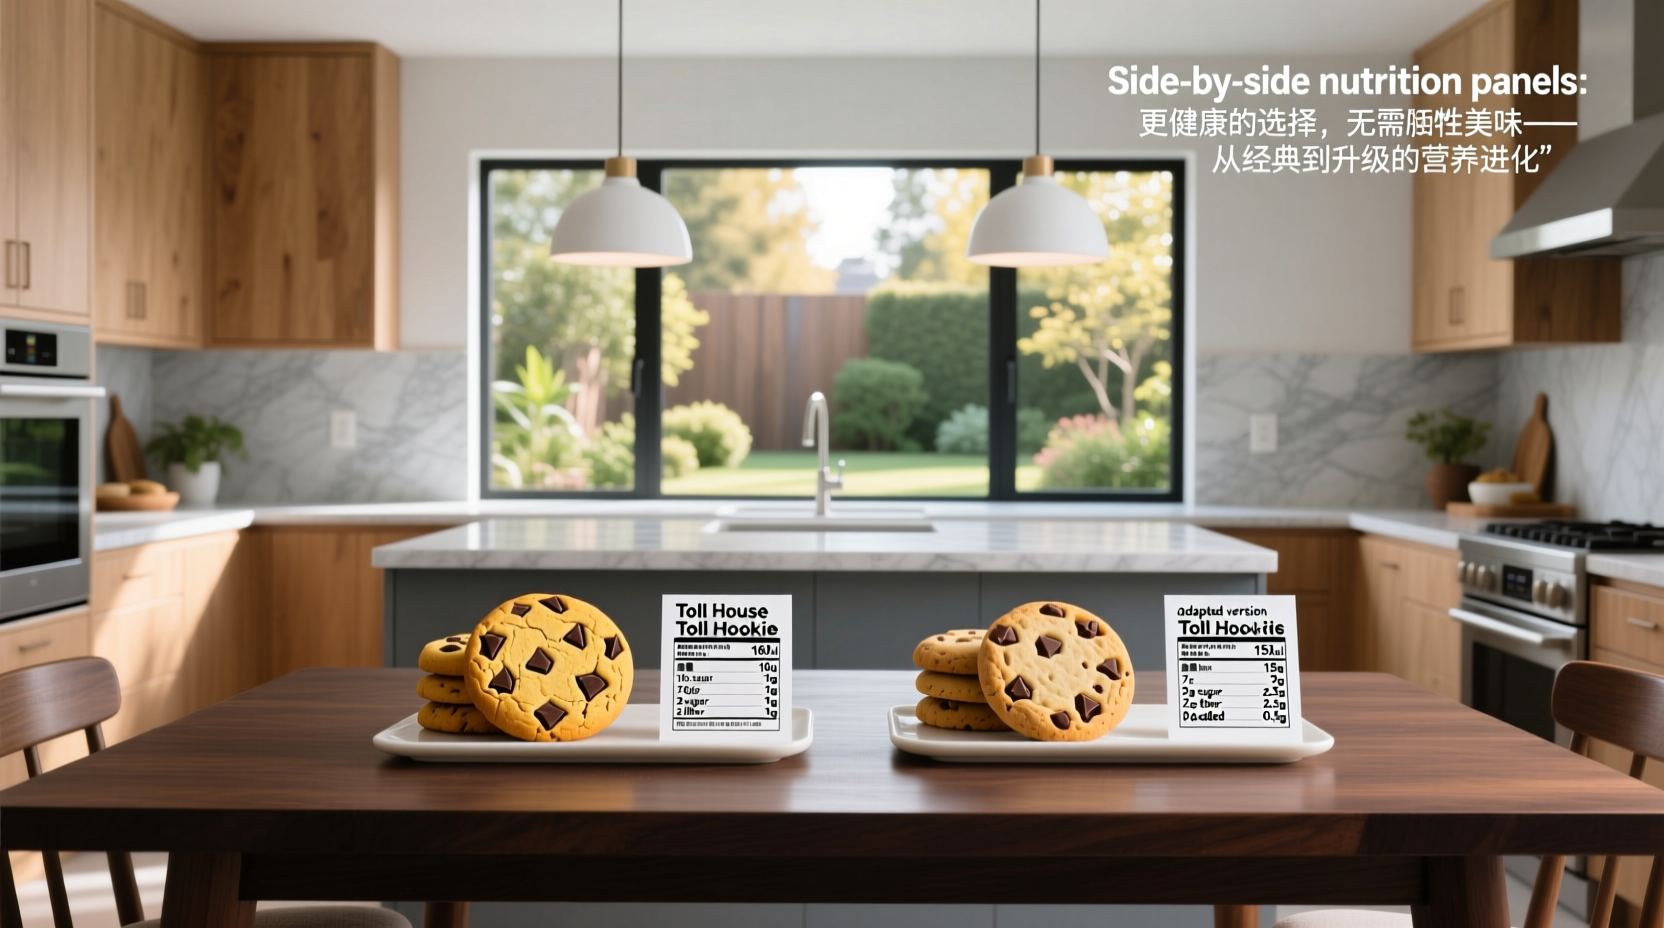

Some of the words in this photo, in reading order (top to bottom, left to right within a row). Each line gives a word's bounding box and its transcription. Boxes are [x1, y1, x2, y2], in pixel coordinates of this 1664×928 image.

[676, 603, 707, 618] Toll
[713, 603, 768, 618] House
[1227, 606, 1267, 616] version
[676, 621, 707, 636] Toll
[714, 621, 778, 636] Hookie
[1178, 620, 1210, 635] Toll
